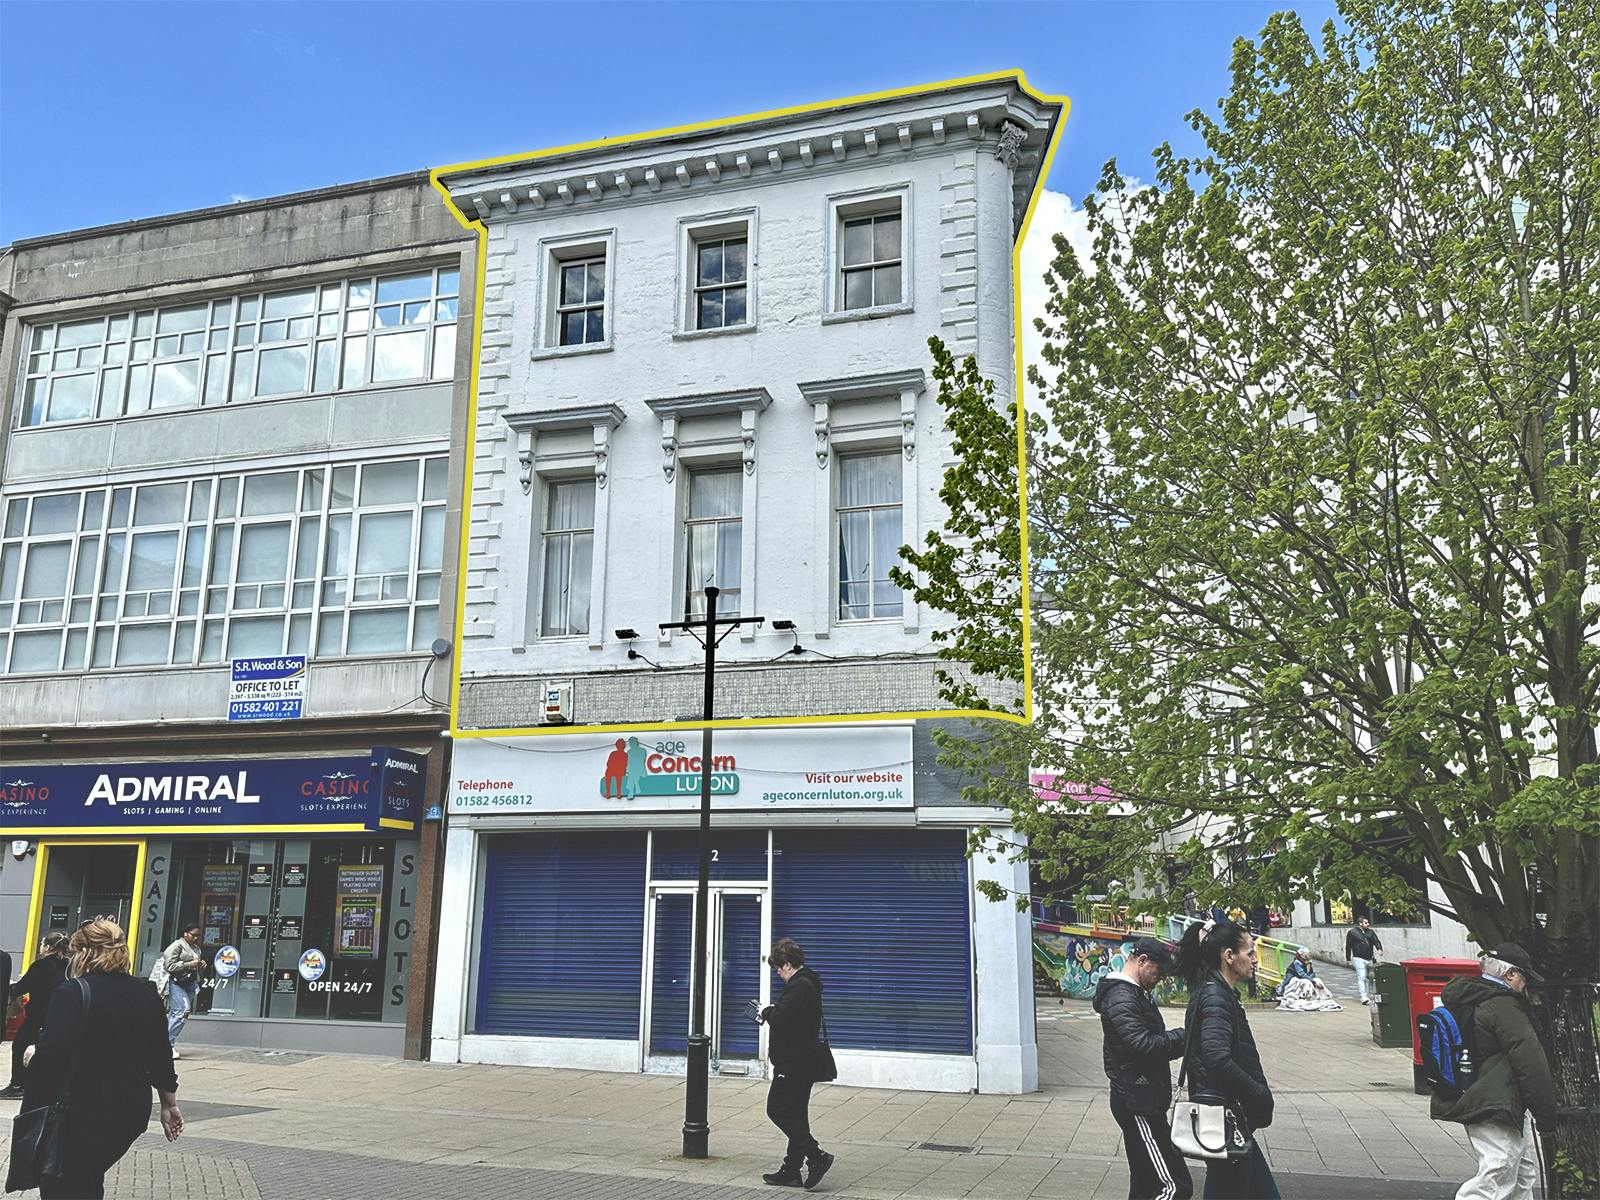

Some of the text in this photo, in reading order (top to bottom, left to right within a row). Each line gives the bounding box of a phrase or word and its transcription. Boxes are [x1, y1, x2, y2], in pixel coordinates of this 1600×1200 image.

[235, 660, 302, 672] S.R. Wood & Son
[236, 680, 300, 692] OFFICE TO LET
[232, 701, 299, 713] 01582 401 221
[656, 740, 686, 755] age
[385, 758, 418, 773] ADMIRAL
[647, 754, 736, 773] Concrn
[806, 772, 903, 784] Visit our website
[84, 771, 260, 806] ADMIRAL
[458, 780, 513, 792] Telephone
[456, 795, 532, 806] 01582 456812
[763, 788, 903, 803] ageconcernluton.org.uk
[388, 796, 410, 808] SLOTS
[712, 850, 719, 861] 2
[390, 854, 414, 1006] SLOTS
[201, 979, 229, 990] 24/7
[308, 982, 340, 993] OPEN
[343, 982, 373, 994] 24/7
